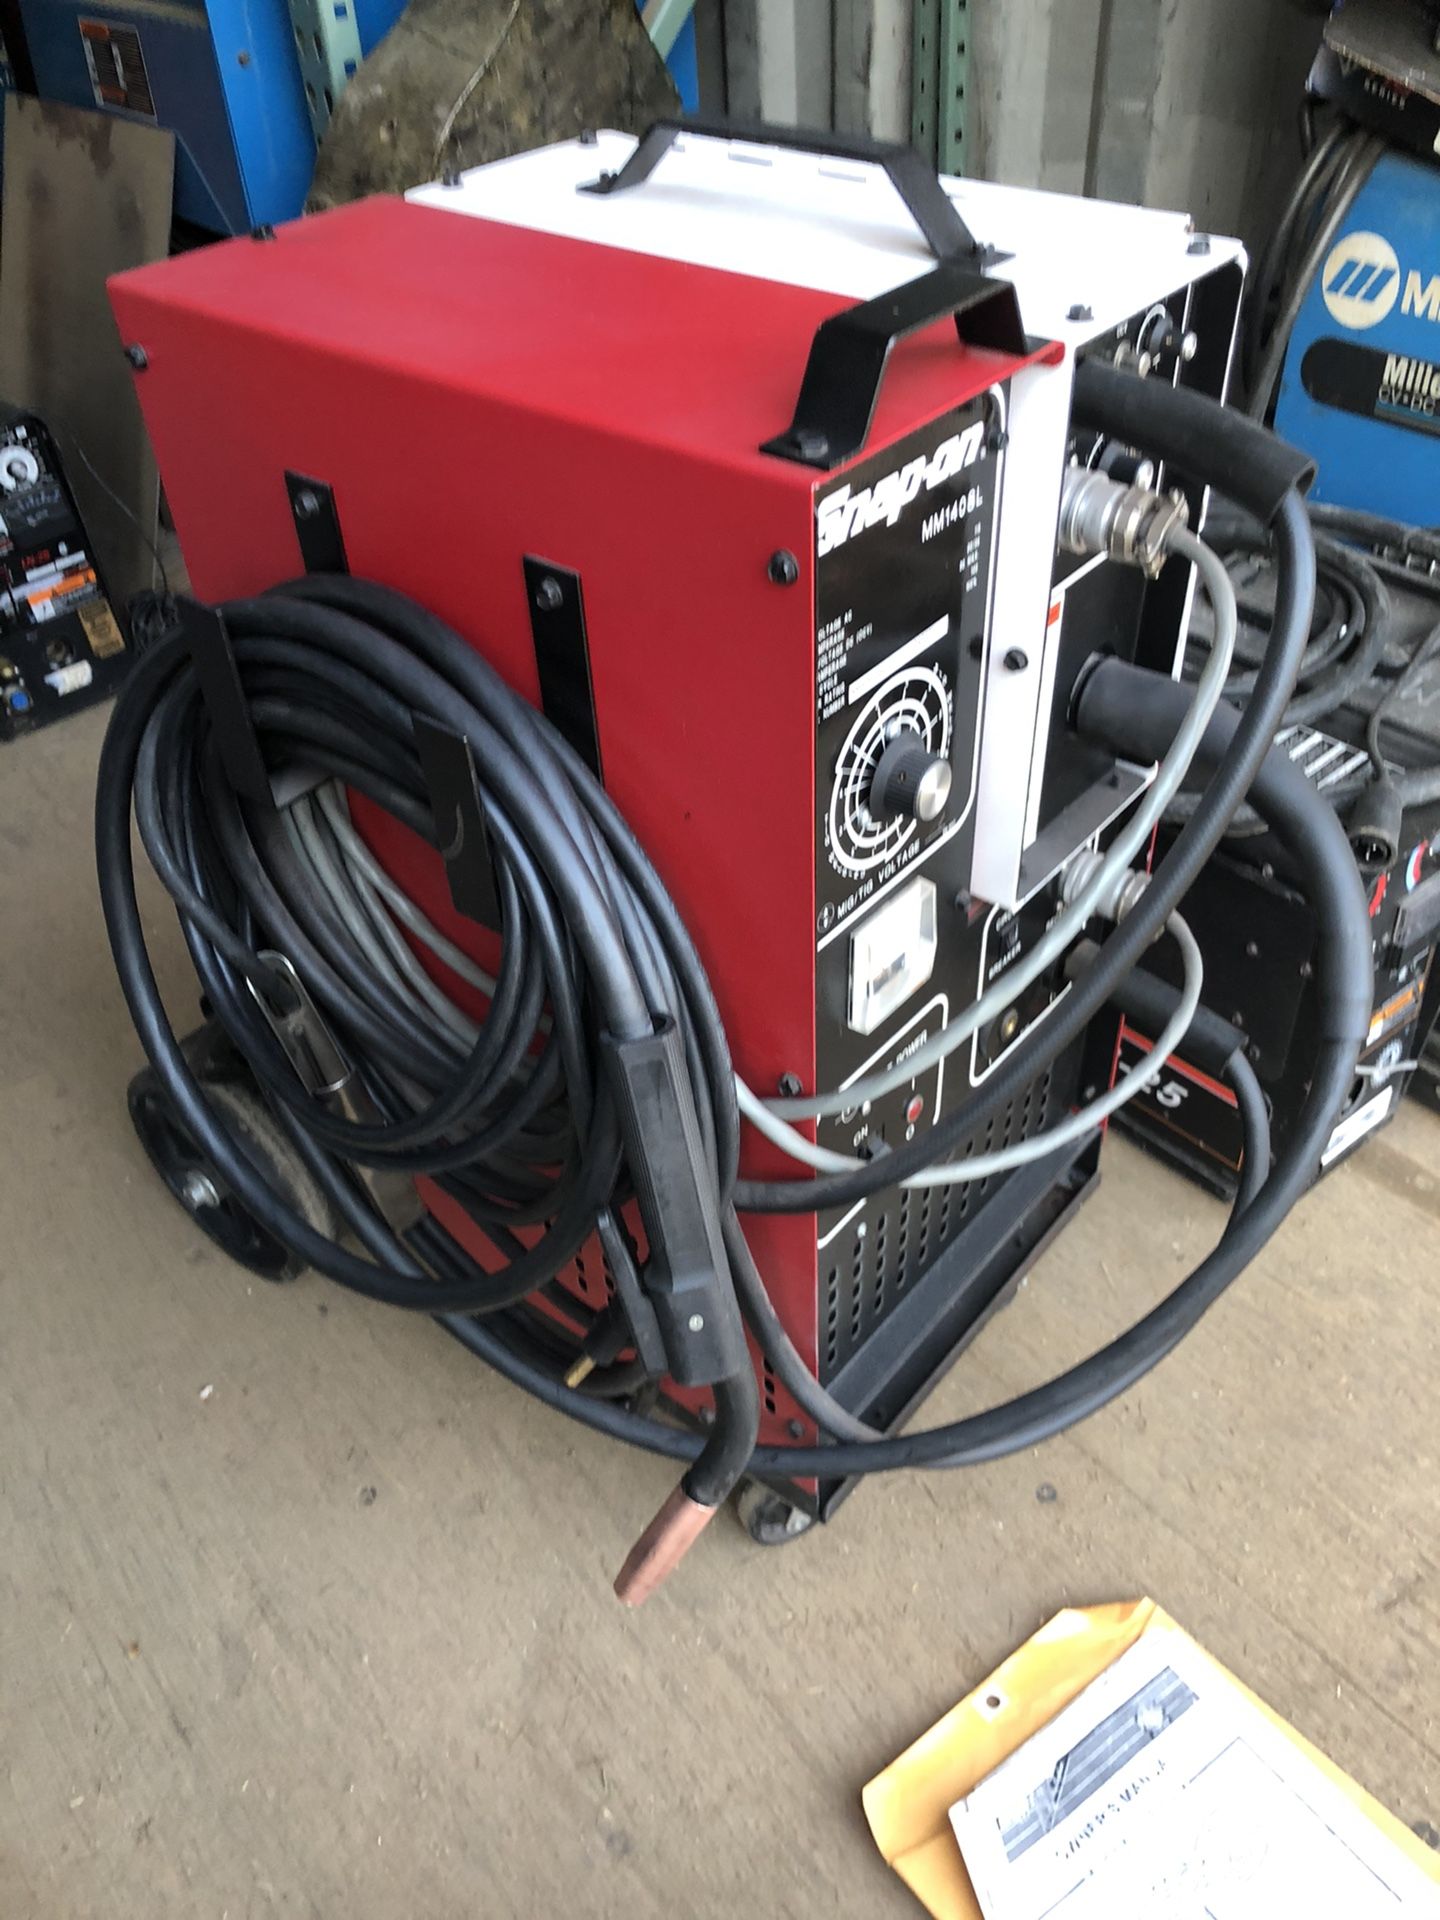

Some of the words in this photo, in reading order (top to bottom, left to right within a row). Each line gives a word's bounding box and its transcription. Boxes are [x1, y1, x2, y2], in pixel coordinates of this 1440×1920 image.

[817, 420, 984, 558] Snap-on
[837, 878, 873, 920] MIG/TIG
[878, 839, 920, 885] VOLTAGE
[896, 1029, 927, 1065] POWER
[853, 1123, 868, 1147] ON
